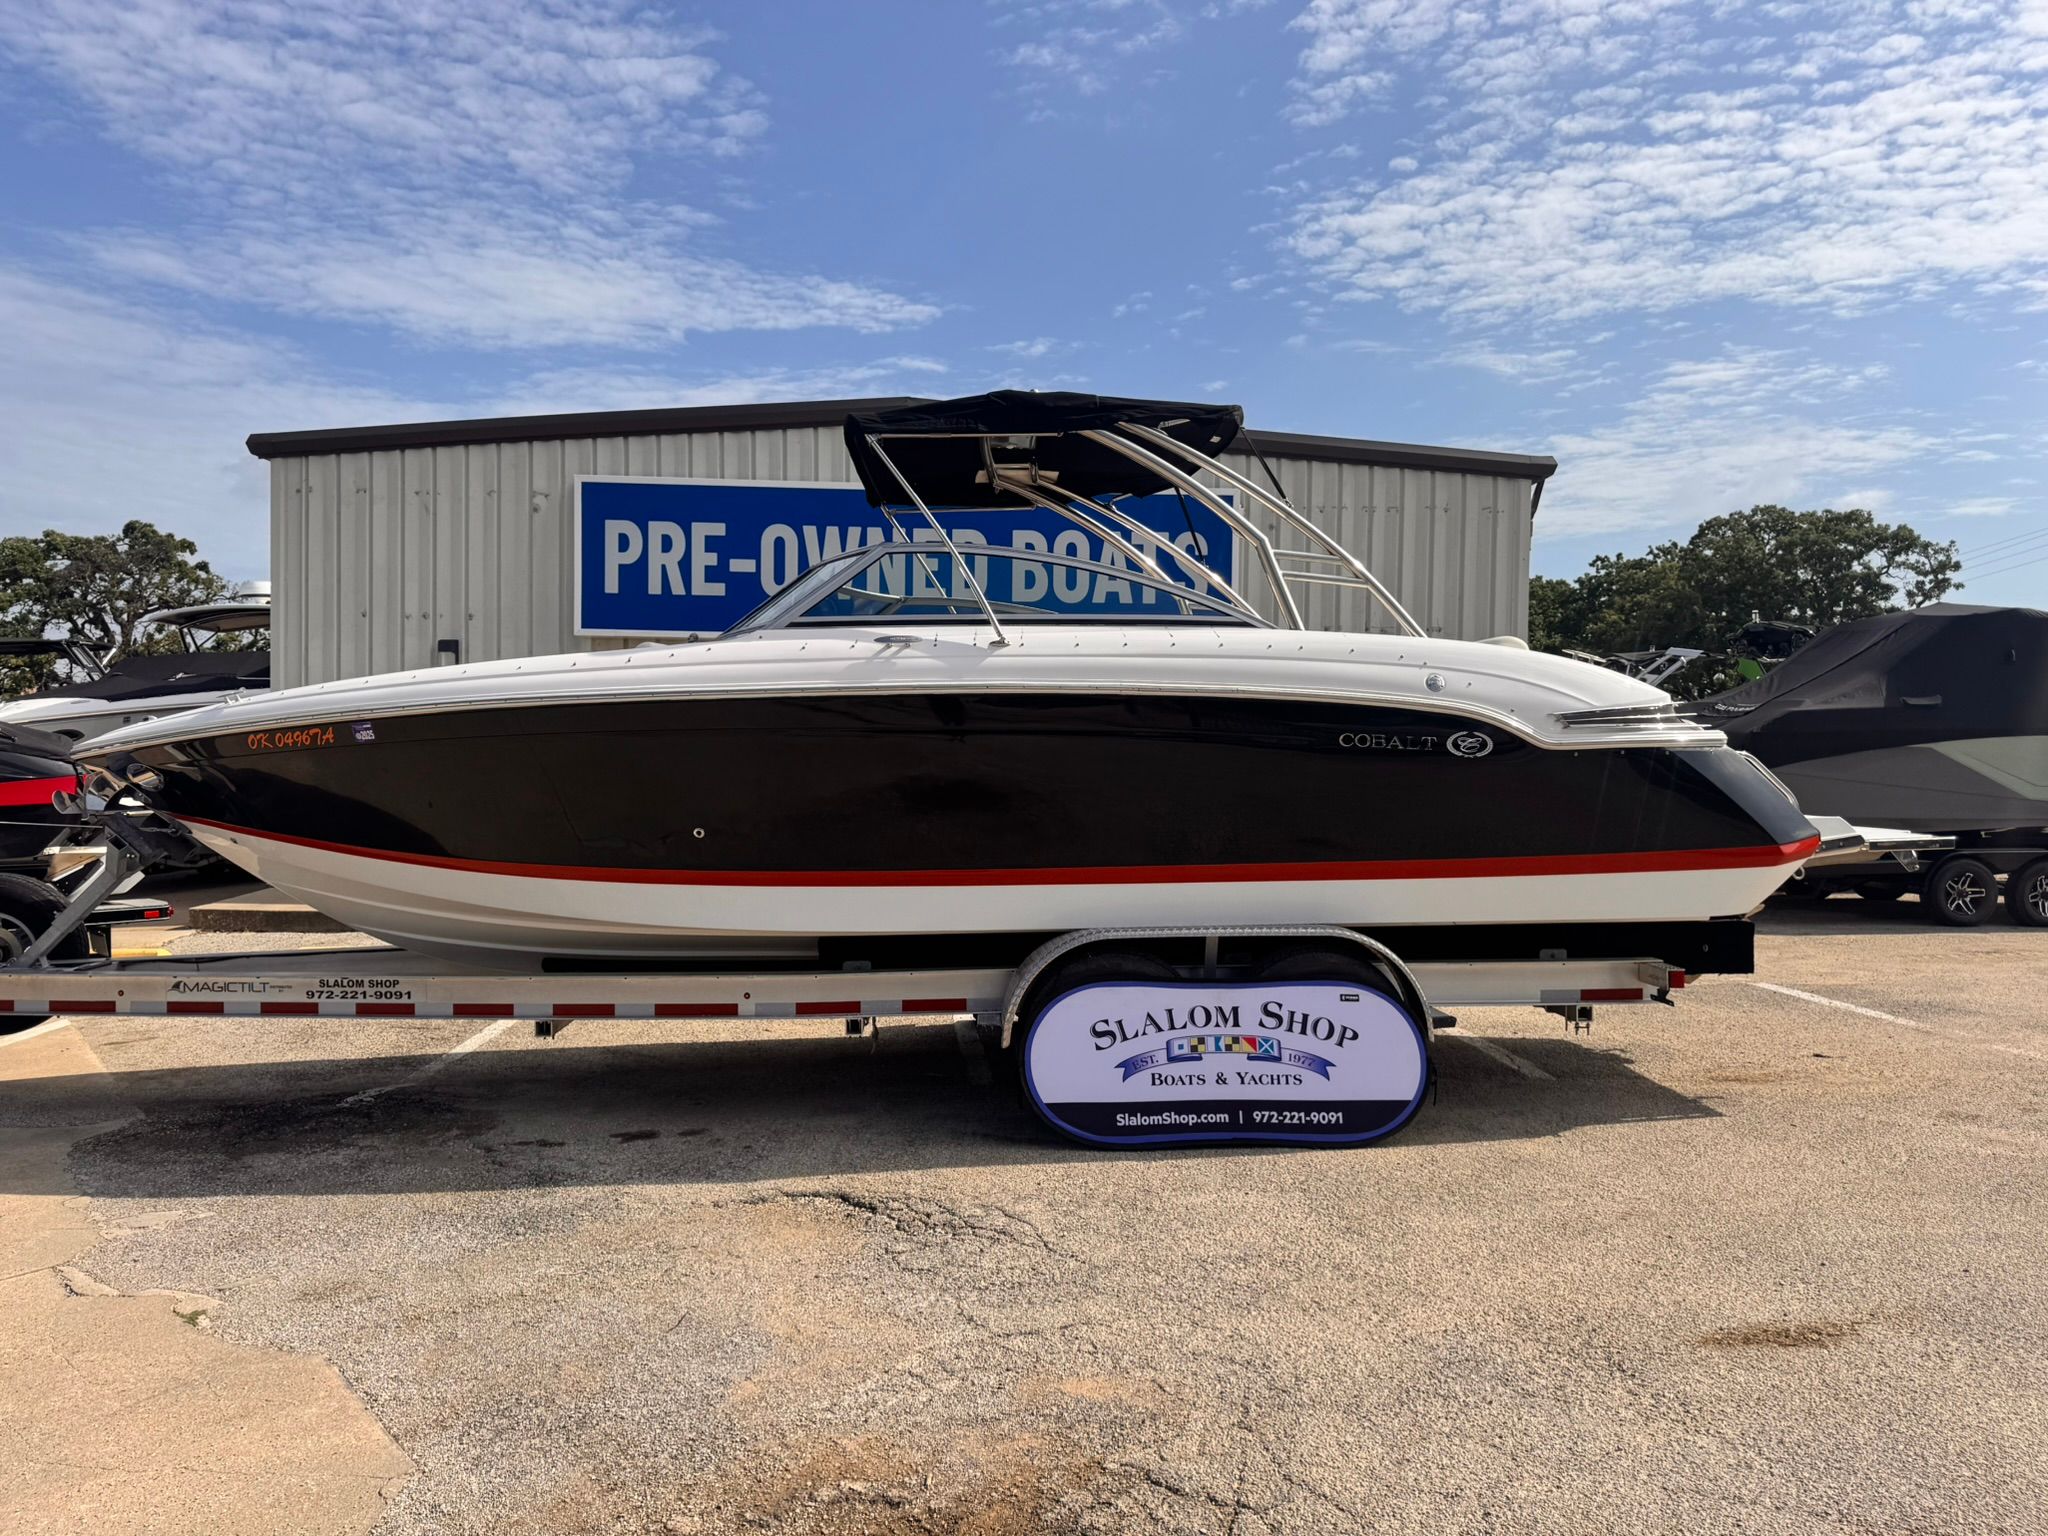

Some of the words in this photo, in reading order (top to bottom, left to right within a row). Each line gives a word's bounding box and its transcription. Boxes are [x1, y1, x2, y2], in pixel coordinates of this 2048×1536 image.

[604, 519, 987, 602] PRE-OWNED
[1012, 529, 1208, 604] BOATS
[247, 732, 274, 750] OK
[275, 727, 335, 748] 04967A
[1338, 732, 1438, 751] COBALT
[183, 980, 270, 993] MAGICTILT
[318, 978, 365, 989] SLALOM
[368, 979, 400, 989] SHOP
[305, 990, 412, 1000] 972-221-9091
[1089, 1005, 1241, 1051] SLALOM
[1258, 1000, 1360, 1049] SHOP
[1131, 1055, 1159, 1071] EST.
[1287, 1052, 1315, 1067] 1977
[1150, 1072, 1206, 1087] BOATS
[1215, 1071, 1228, 1086] &
[1236, 1071, 1303, 1086] YACHTS
[1116, 1112, 1229, 1127] SlalomShop.com
[1252, 1111, 1344, 1125] 972-221-9091
